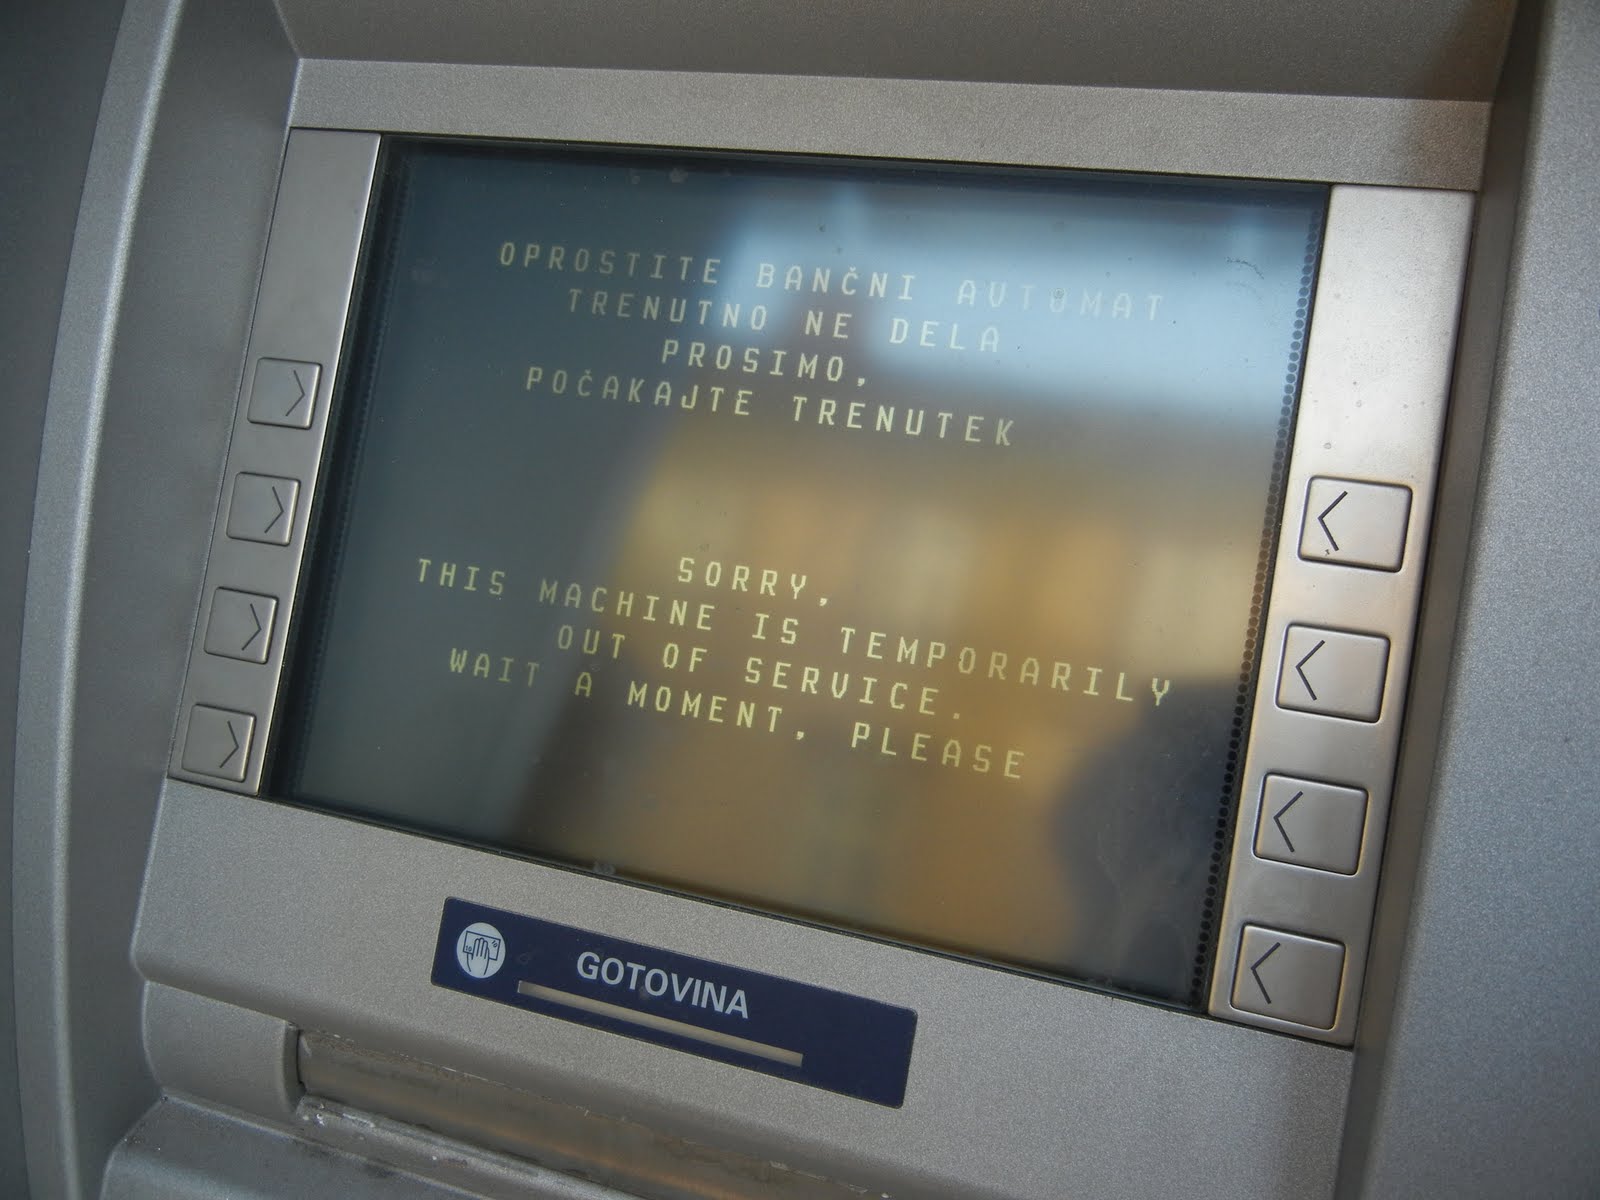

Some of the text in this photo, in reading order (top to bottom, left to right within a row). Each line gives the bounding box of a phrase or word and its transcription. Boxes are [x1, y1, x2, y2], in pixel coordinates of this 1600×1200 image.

[499, 241, 721, 284] OPROSTITE
[755, 262, 916, 301] BANČNI
[568, 288, 1000, 353] TRENUTNO NE DELA
[660, 338, 866, 387] PROSIMO,
[525, 366, 1014, 446] POČAKAJTE TRENUTEK
[677, 556, 828, 607] SORRY,
[418, 558, 1170, 706] THIS MACHINE IS TEMPORARILY
[557, 624, 961, 720] OUT OF SERVICE.
[449, 647, 1025, 779] WAIT A MOMENT, PLEASE
[576, 951, 749, 1020] GOTOVINA
